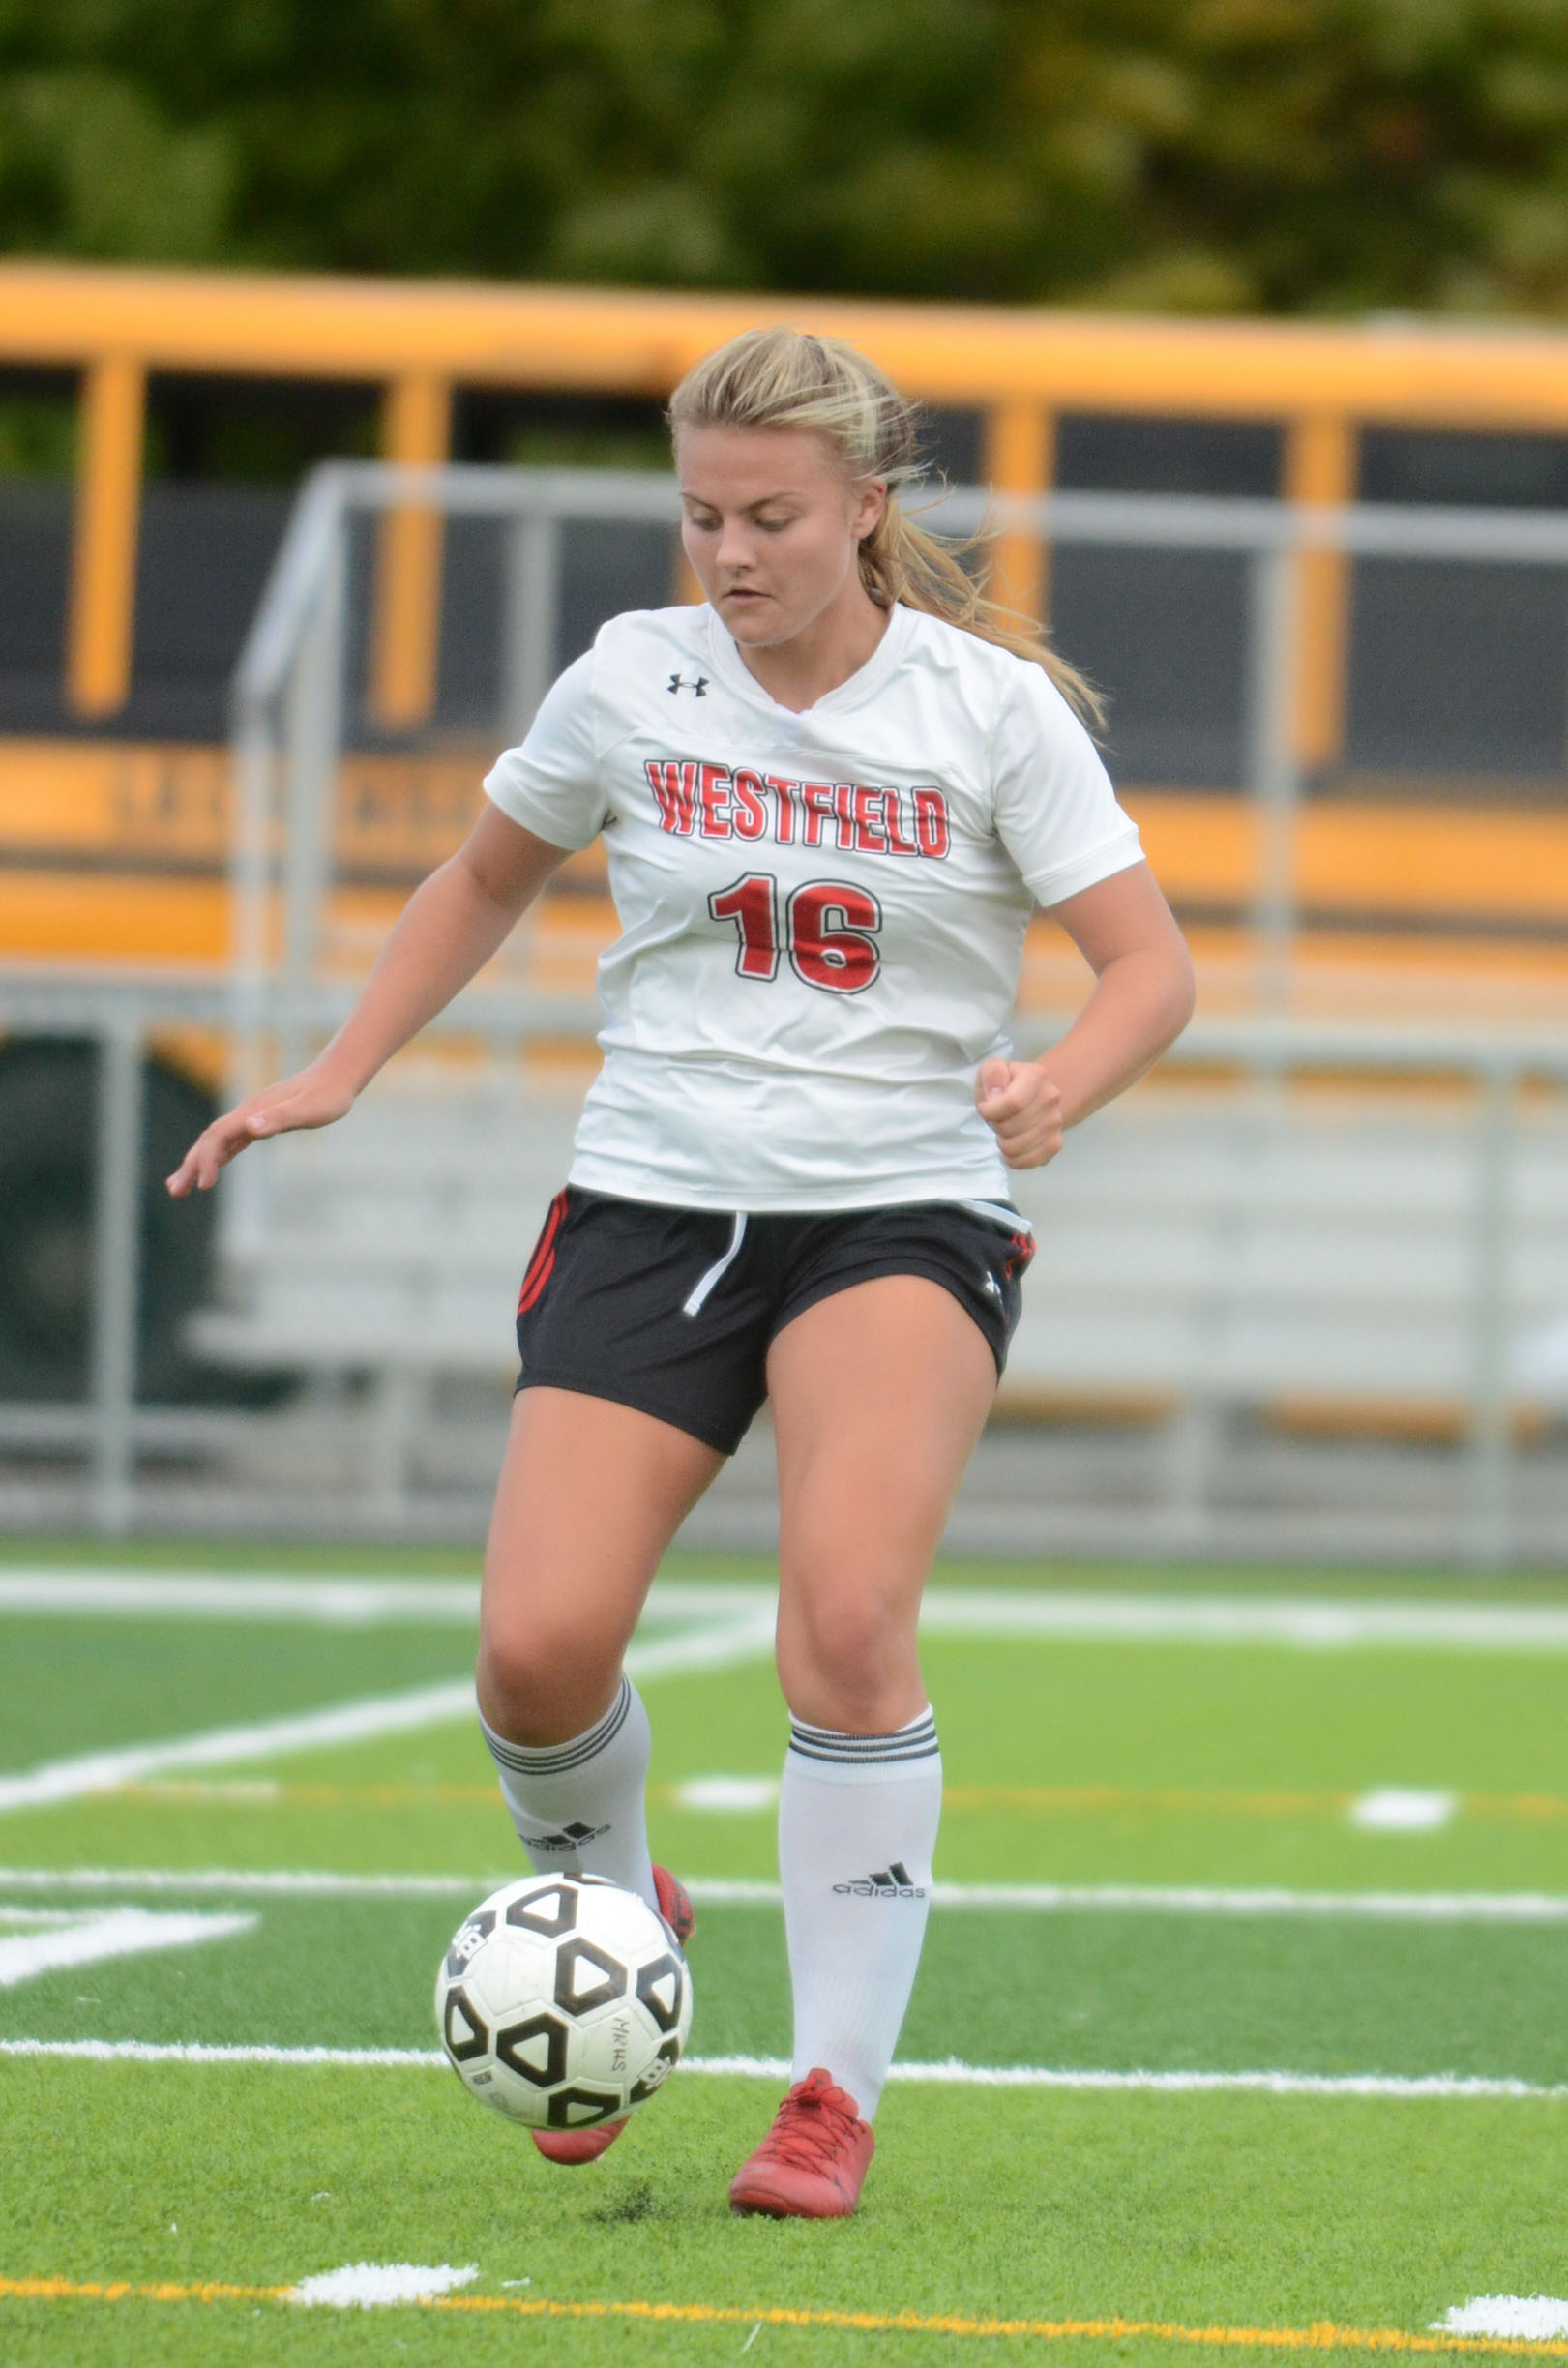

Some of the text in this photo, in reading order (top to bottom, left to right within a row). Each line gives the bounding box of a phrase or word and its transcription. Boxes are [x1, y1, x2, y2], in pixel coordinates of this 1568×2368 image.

[644, 760, 951, 859] WESTFIELD
[708, 872, 882, 995] 16
[832, 1884, 926, 1898] adidas
